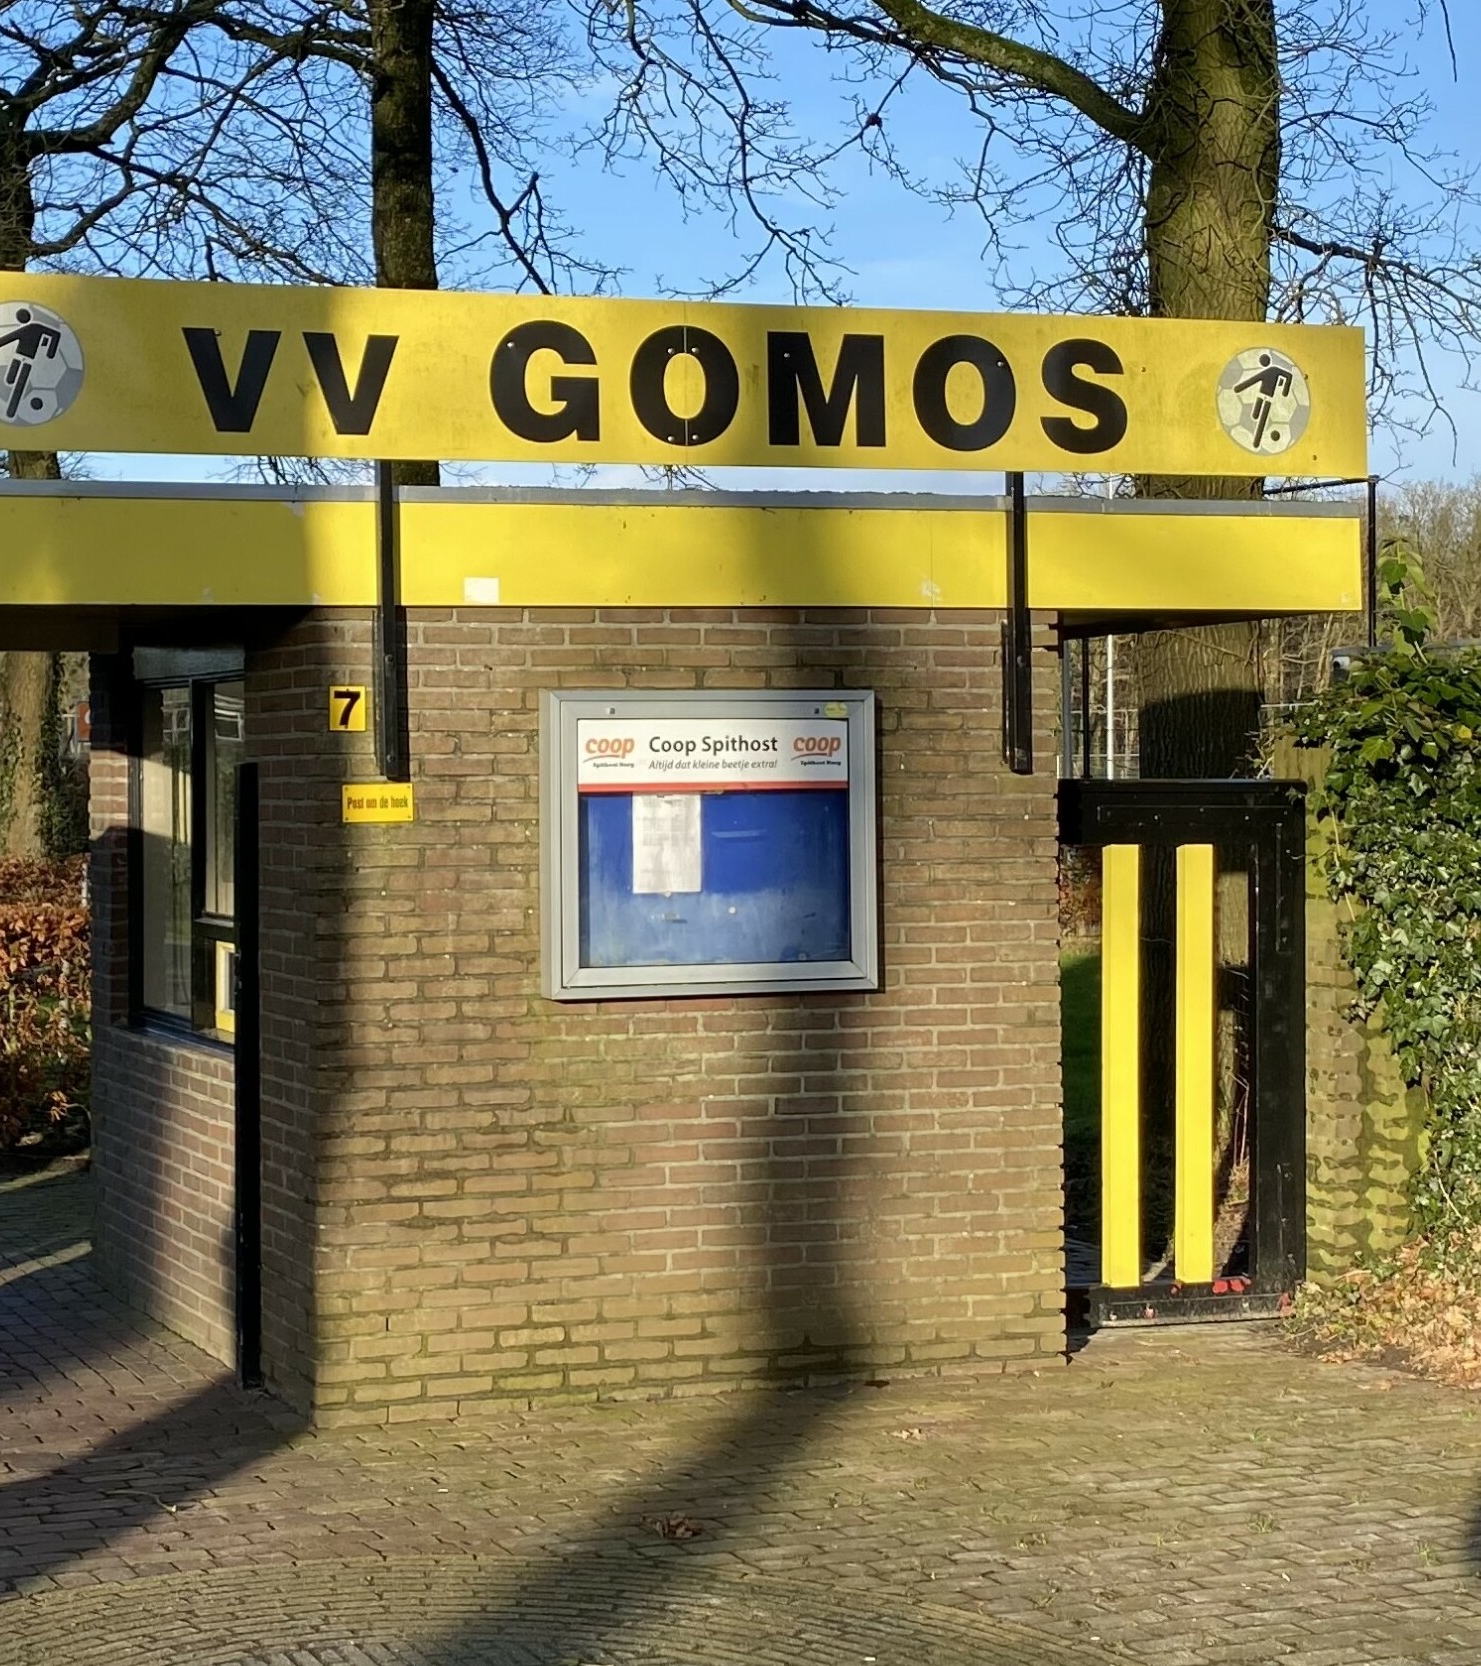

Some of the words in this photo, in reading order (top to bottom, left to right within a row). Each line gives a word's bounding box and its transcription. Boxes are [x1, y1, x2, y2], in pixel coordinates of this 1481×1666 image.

[182, 326, 400, 436] VV
[490, 319, 1128, 455] GOMOS
[334, 691, 361, 726] 7
[649, 736, 696, 756] Coop
[701, 735, 778, 756] Spithost
[648, 759, 673, 771] Altijd
[675, 759, 691, 769] dat
[692, 759, 720, 769] kleine
[722, 759, 750, 771] beetje
[751, 759, 778, 769] extra!
[347, 796, 364, 809] Post
[379, 796, 389, 808] de
